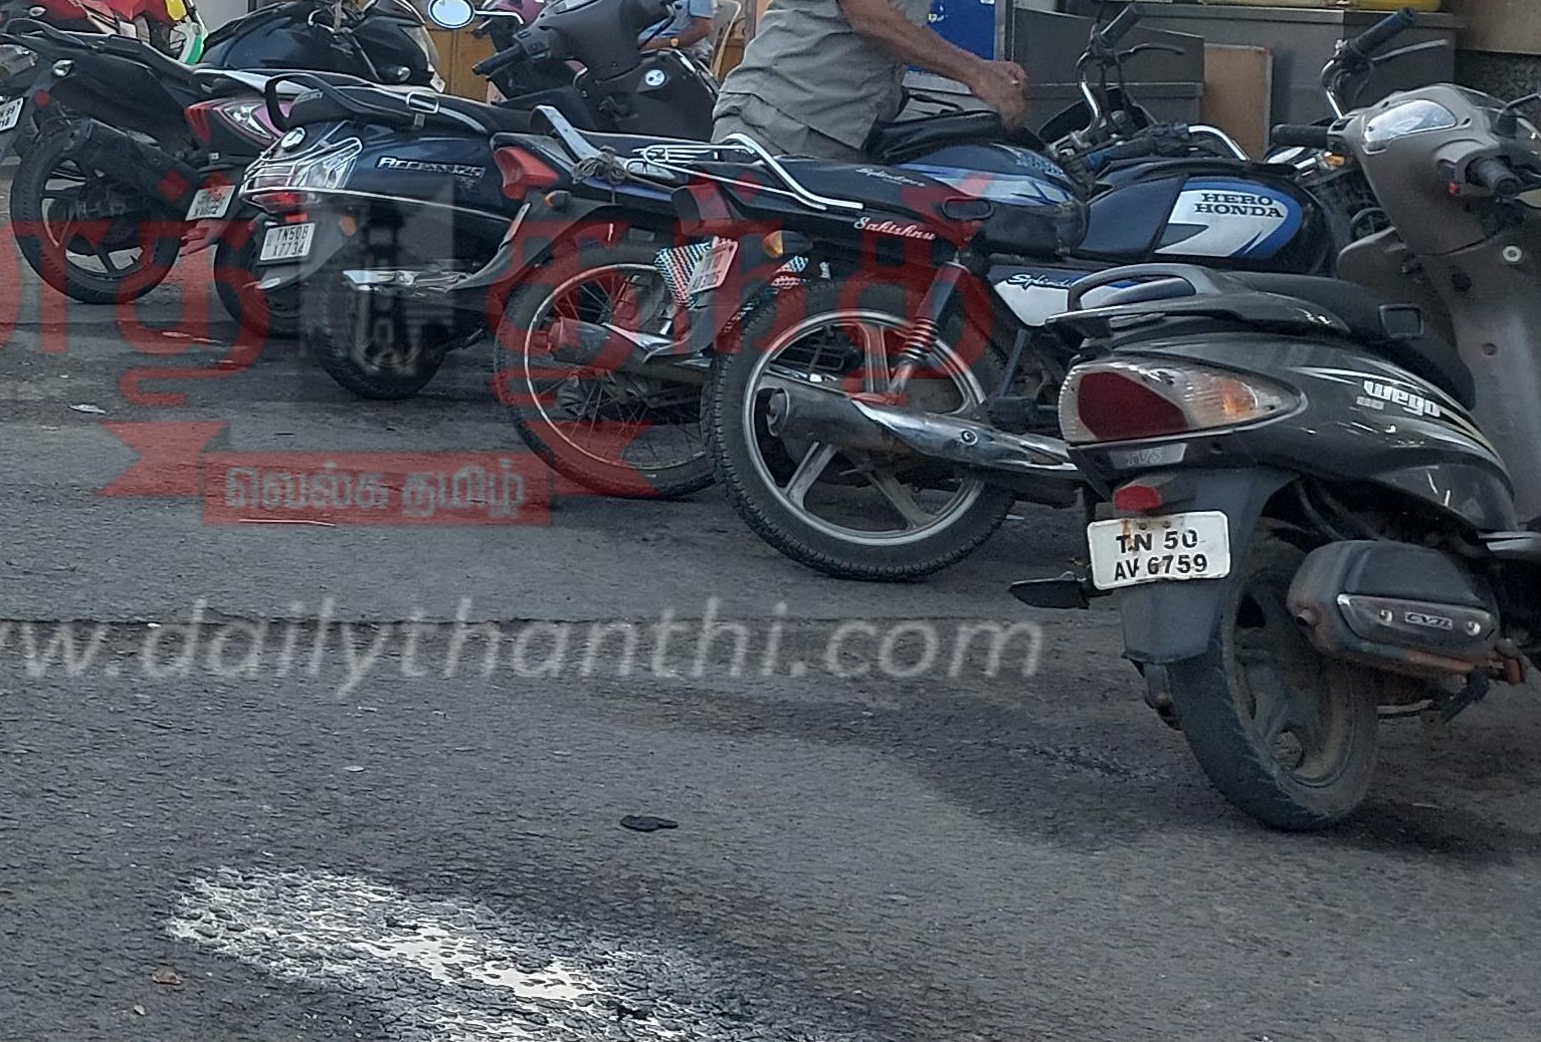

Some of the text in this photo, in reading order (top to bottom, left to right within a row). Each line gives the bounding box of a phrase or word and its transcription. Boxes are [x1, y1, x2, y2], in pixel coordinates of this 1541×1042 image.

[1201, 193, 1273, 206] HERO
[1194, 203, 1284, 218] HONDA
[1115, 530, 1199, 553] TN 50
[1114, 554, 1208, 582] AV 6759
